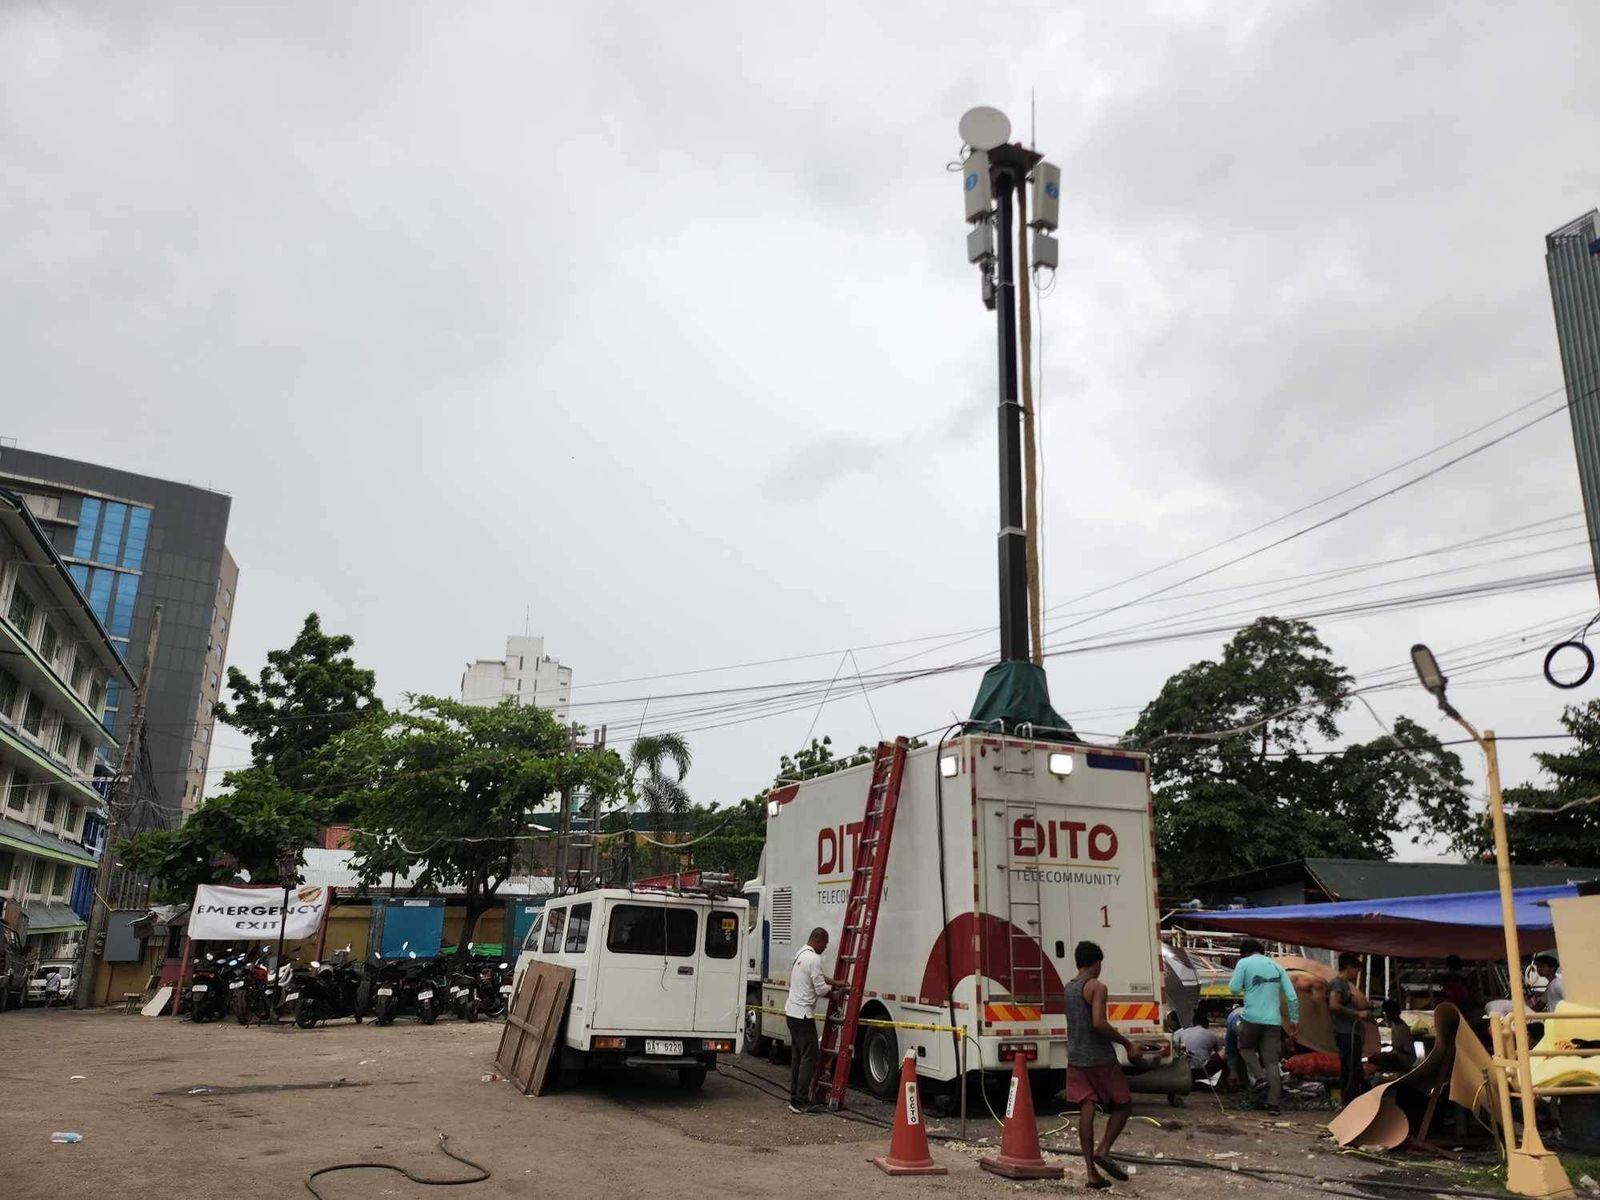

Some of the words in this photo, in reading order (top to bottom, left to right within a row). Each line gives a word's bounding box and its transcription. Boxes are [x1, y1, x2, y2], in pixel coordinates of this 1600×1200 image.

[817, 821, 867, 875] DIT
[1013, 818, 1118, 861] DITO
[1016, 870, 1121, 886] TELECOMMUNITY
[197, 903, 322, 916] EMERGENCY
[1100, 904, 1111, 928] 1
[235, 921, 280, 930] EXIT
